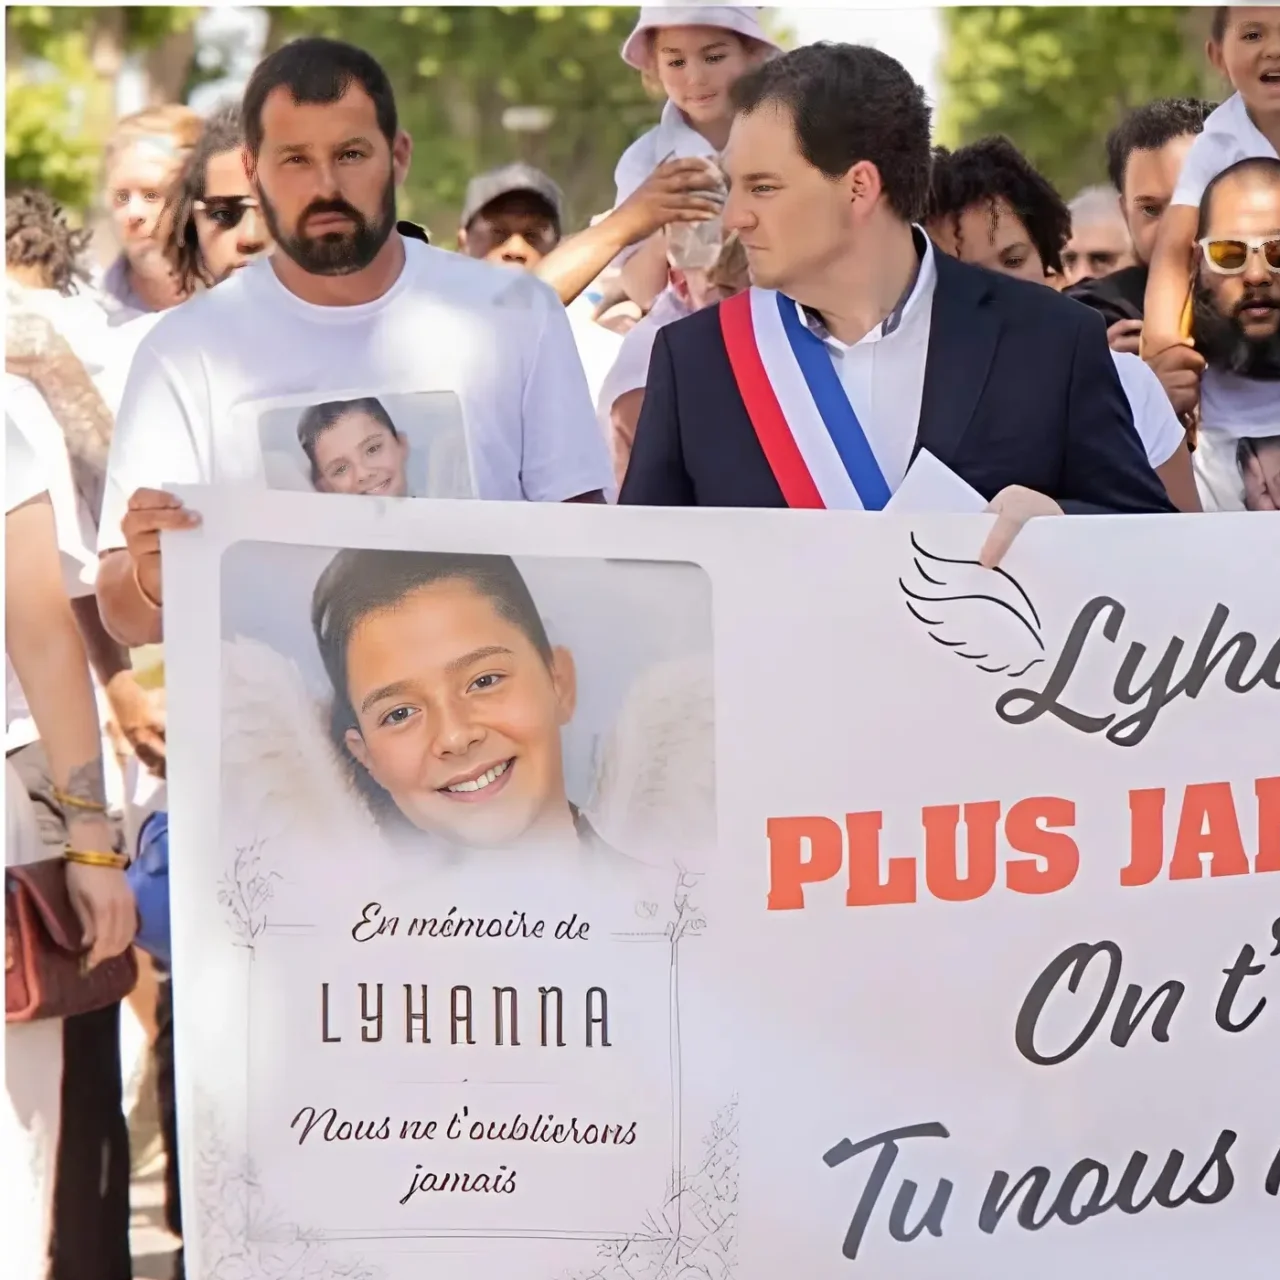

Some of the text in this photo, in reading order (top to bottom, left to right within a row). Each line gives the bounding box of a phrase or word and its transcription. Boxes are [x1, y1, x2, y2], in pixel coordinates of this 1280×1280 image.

[767, 797, 1079, 911] PLUS
[351, 901, 591, 943] En mémoire de
[320, 982, 613, 1048] LYHANNA
[1014, 938, 1186, 1066] On
[290, 1106, 391, 1147] Nous
[398, 1120, 438, 1142] ne
[398, 1163, 517, 1206] jamais
[822, 1121, 954, 1261] Tu
[978, 1128, 1238, 1235] nous
